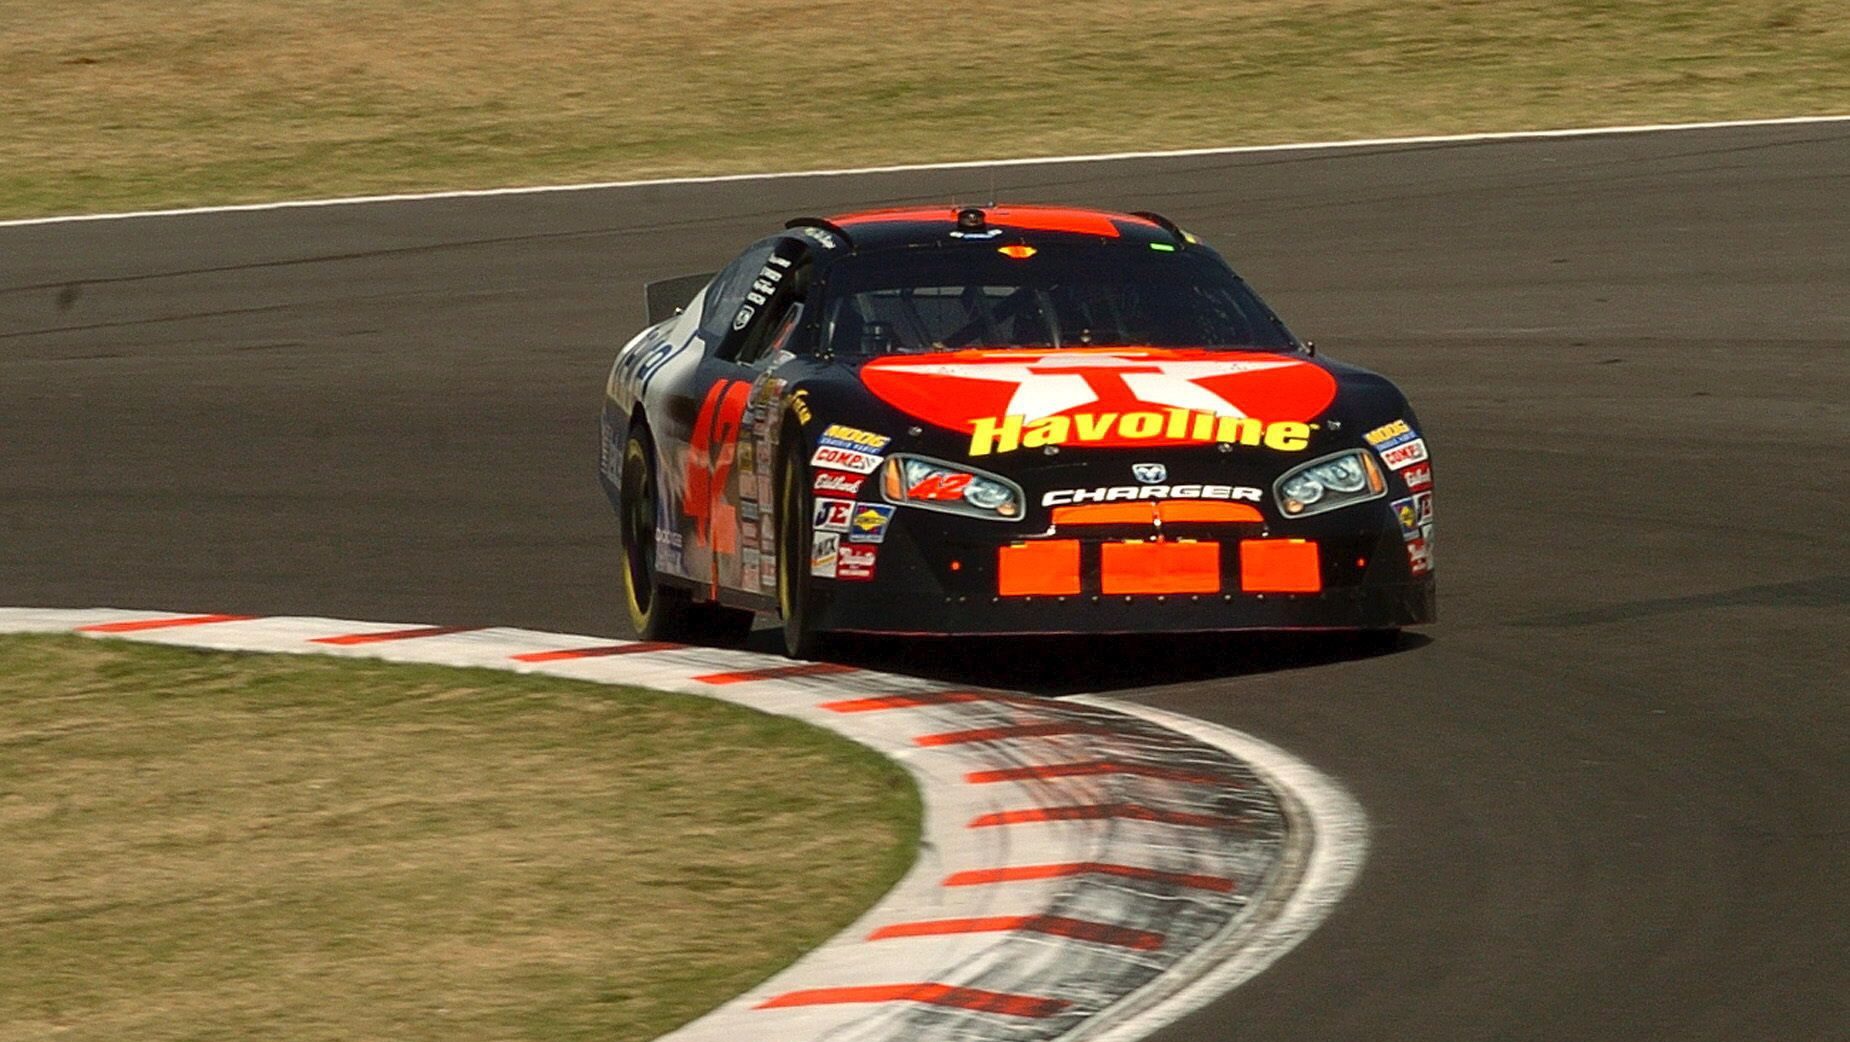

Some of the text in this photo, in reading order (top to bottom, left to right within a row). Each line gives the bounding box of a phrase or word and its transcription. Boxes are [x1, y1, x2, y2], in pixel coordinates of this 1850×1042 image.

[968, 407, 1311, 457] Havoline
[817, 448, 863, 465] COMP
[1041, 484, 1264, 507] CHARGER
[815, 501, 851, 526] JE
